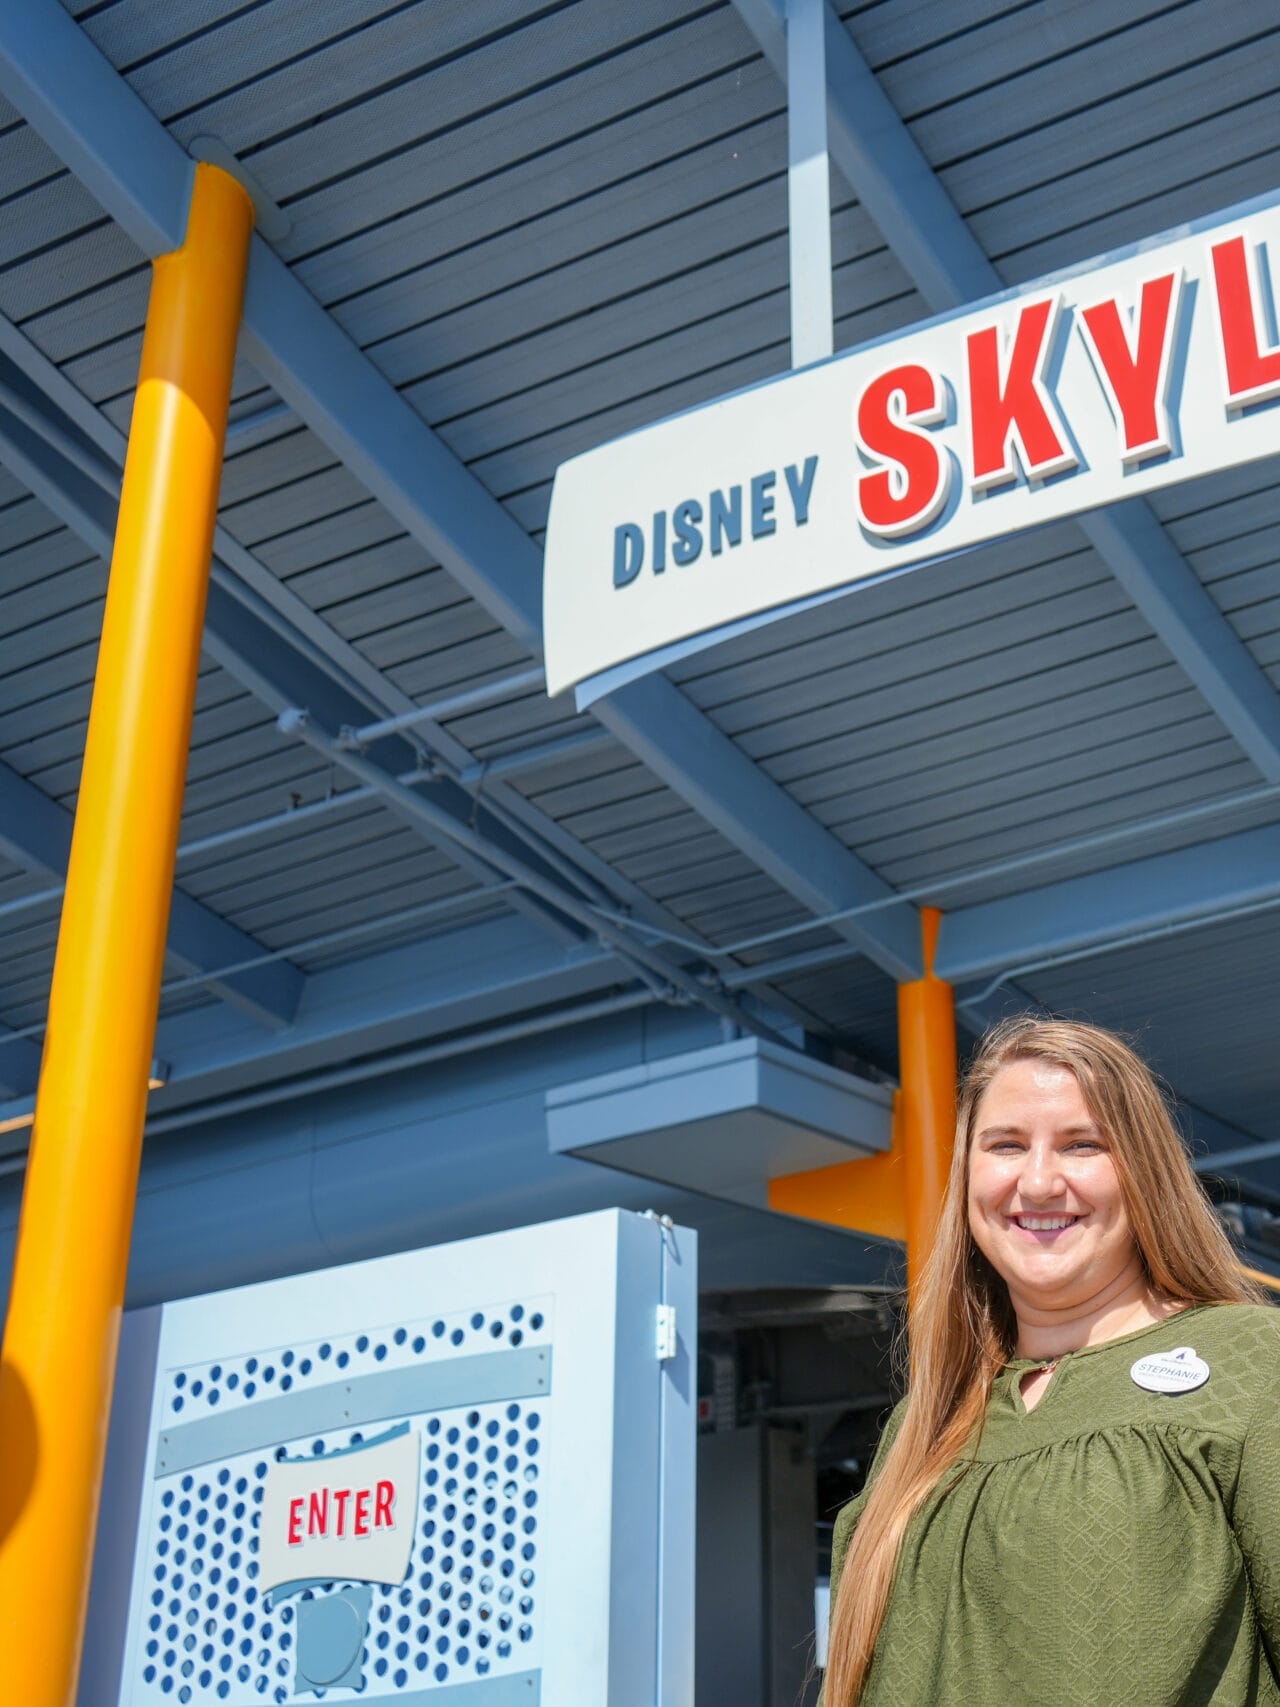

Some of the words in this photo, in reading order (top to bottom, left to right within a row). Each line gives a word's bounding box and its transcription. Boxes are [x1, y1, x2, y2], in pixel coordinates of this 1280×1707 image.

[613, 454, 819, 590] DISNEY
[1138, 1363, 1202, 1381] STEPHANIE
[288, 1480, 396, 1545] ENTER
